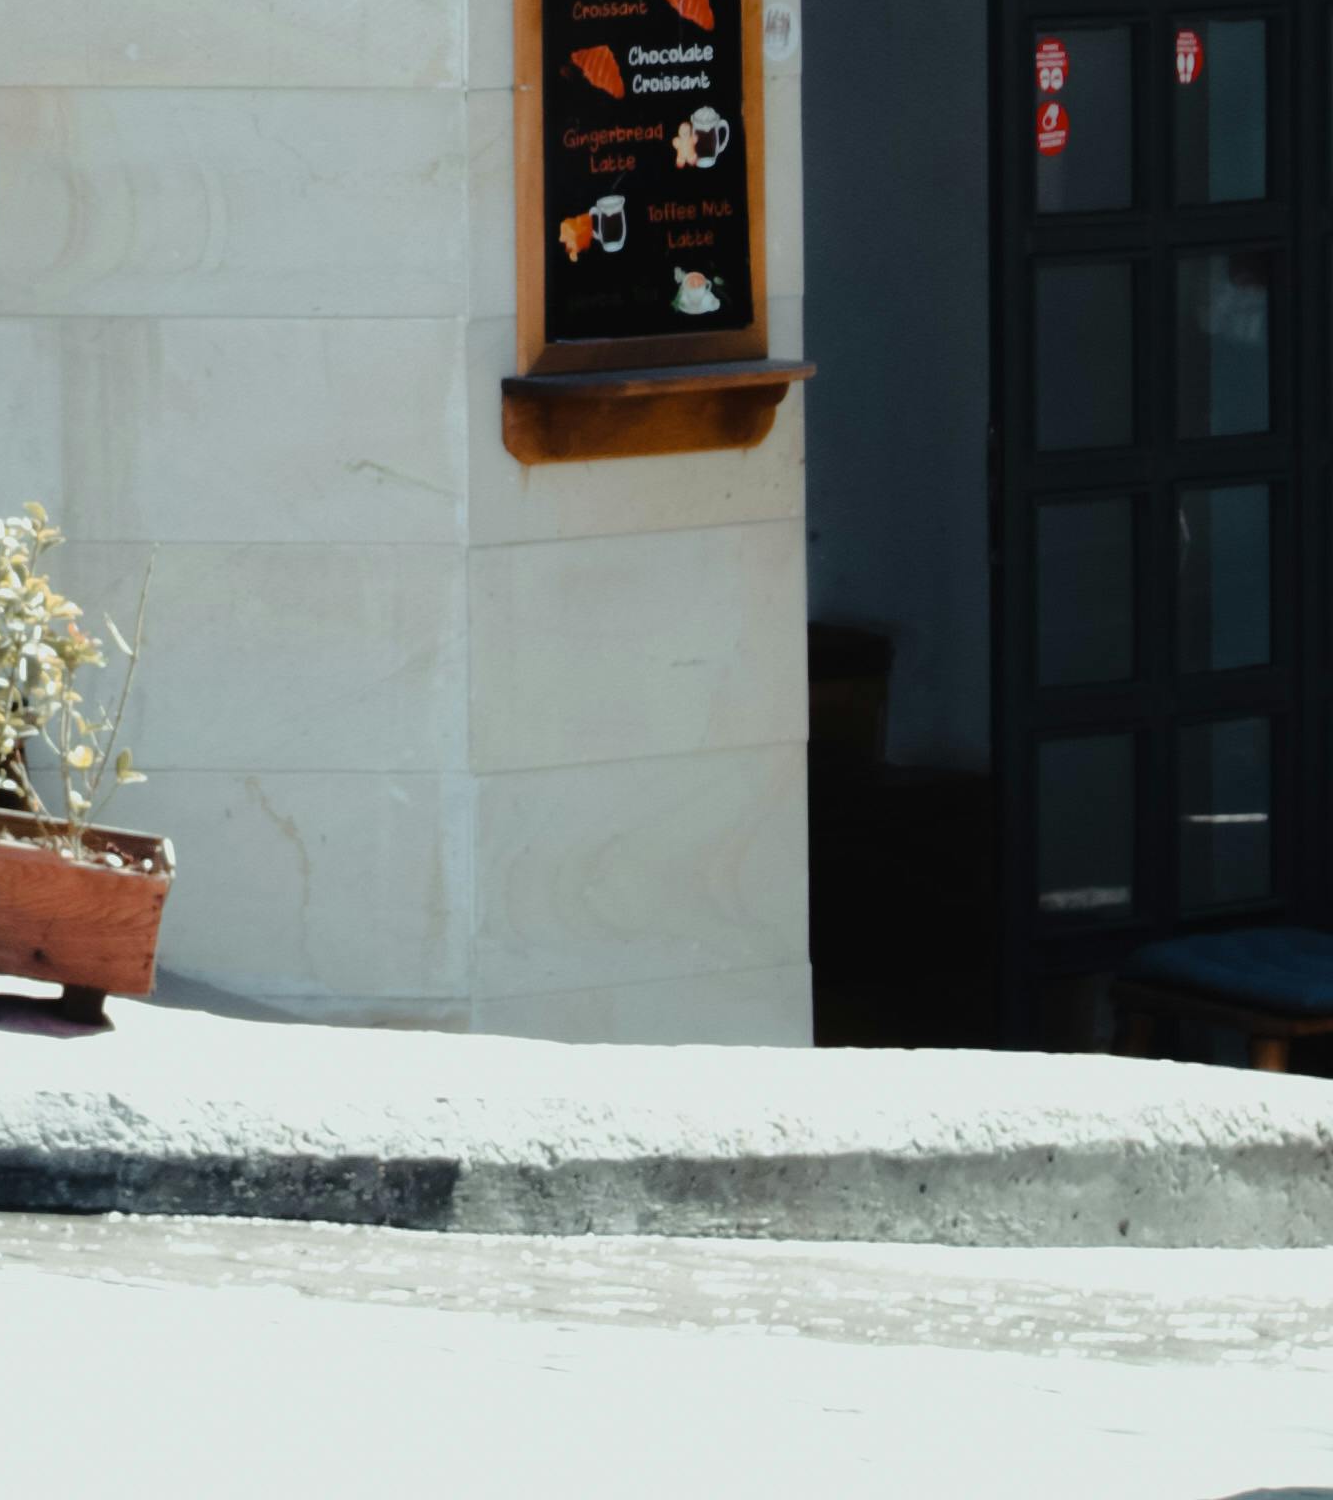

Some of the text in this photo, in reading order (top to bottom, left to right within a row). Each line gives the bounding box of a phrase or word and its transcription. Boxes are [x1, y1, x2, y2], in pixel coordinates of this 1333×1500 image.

[572, 0, 649, 21] Croissant
[628, 43, 715, 67] Chocolate
[632, 71, 711, 94] Croissant
[562, 122, 665, 152] Gingerbread
[589, 154, 637, 173] Latte
[647, 199, 733, 222] Toffee Nut
[668, 230, 715, 248] Latte
